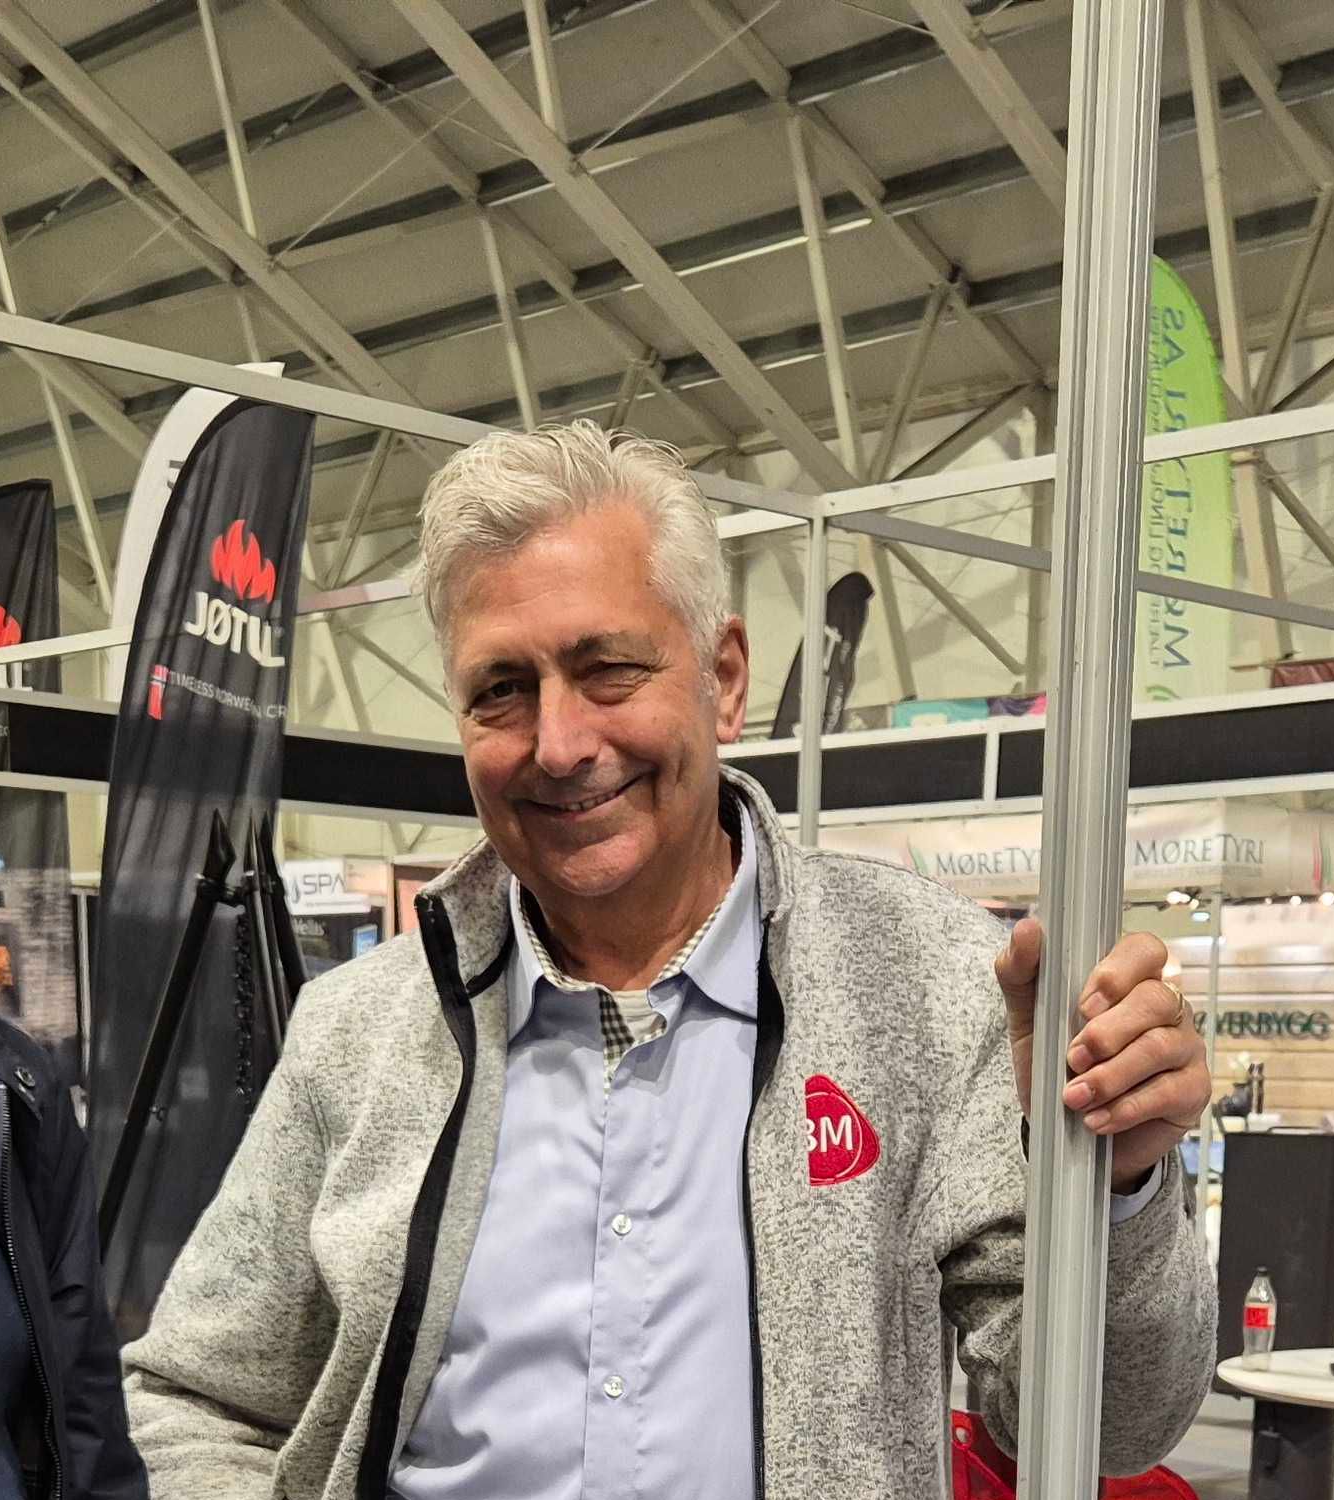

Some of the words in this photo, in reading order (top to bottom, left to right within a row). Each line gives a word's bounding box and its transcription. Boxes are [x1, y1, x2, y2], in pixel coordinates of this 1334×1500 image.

[184, 591, 285, 667] JØTUL
[937, 847, 1041, 875] MØRETY
[302, 873, 346, 896] SPA
[804, 1114, 853, 1152] BM
